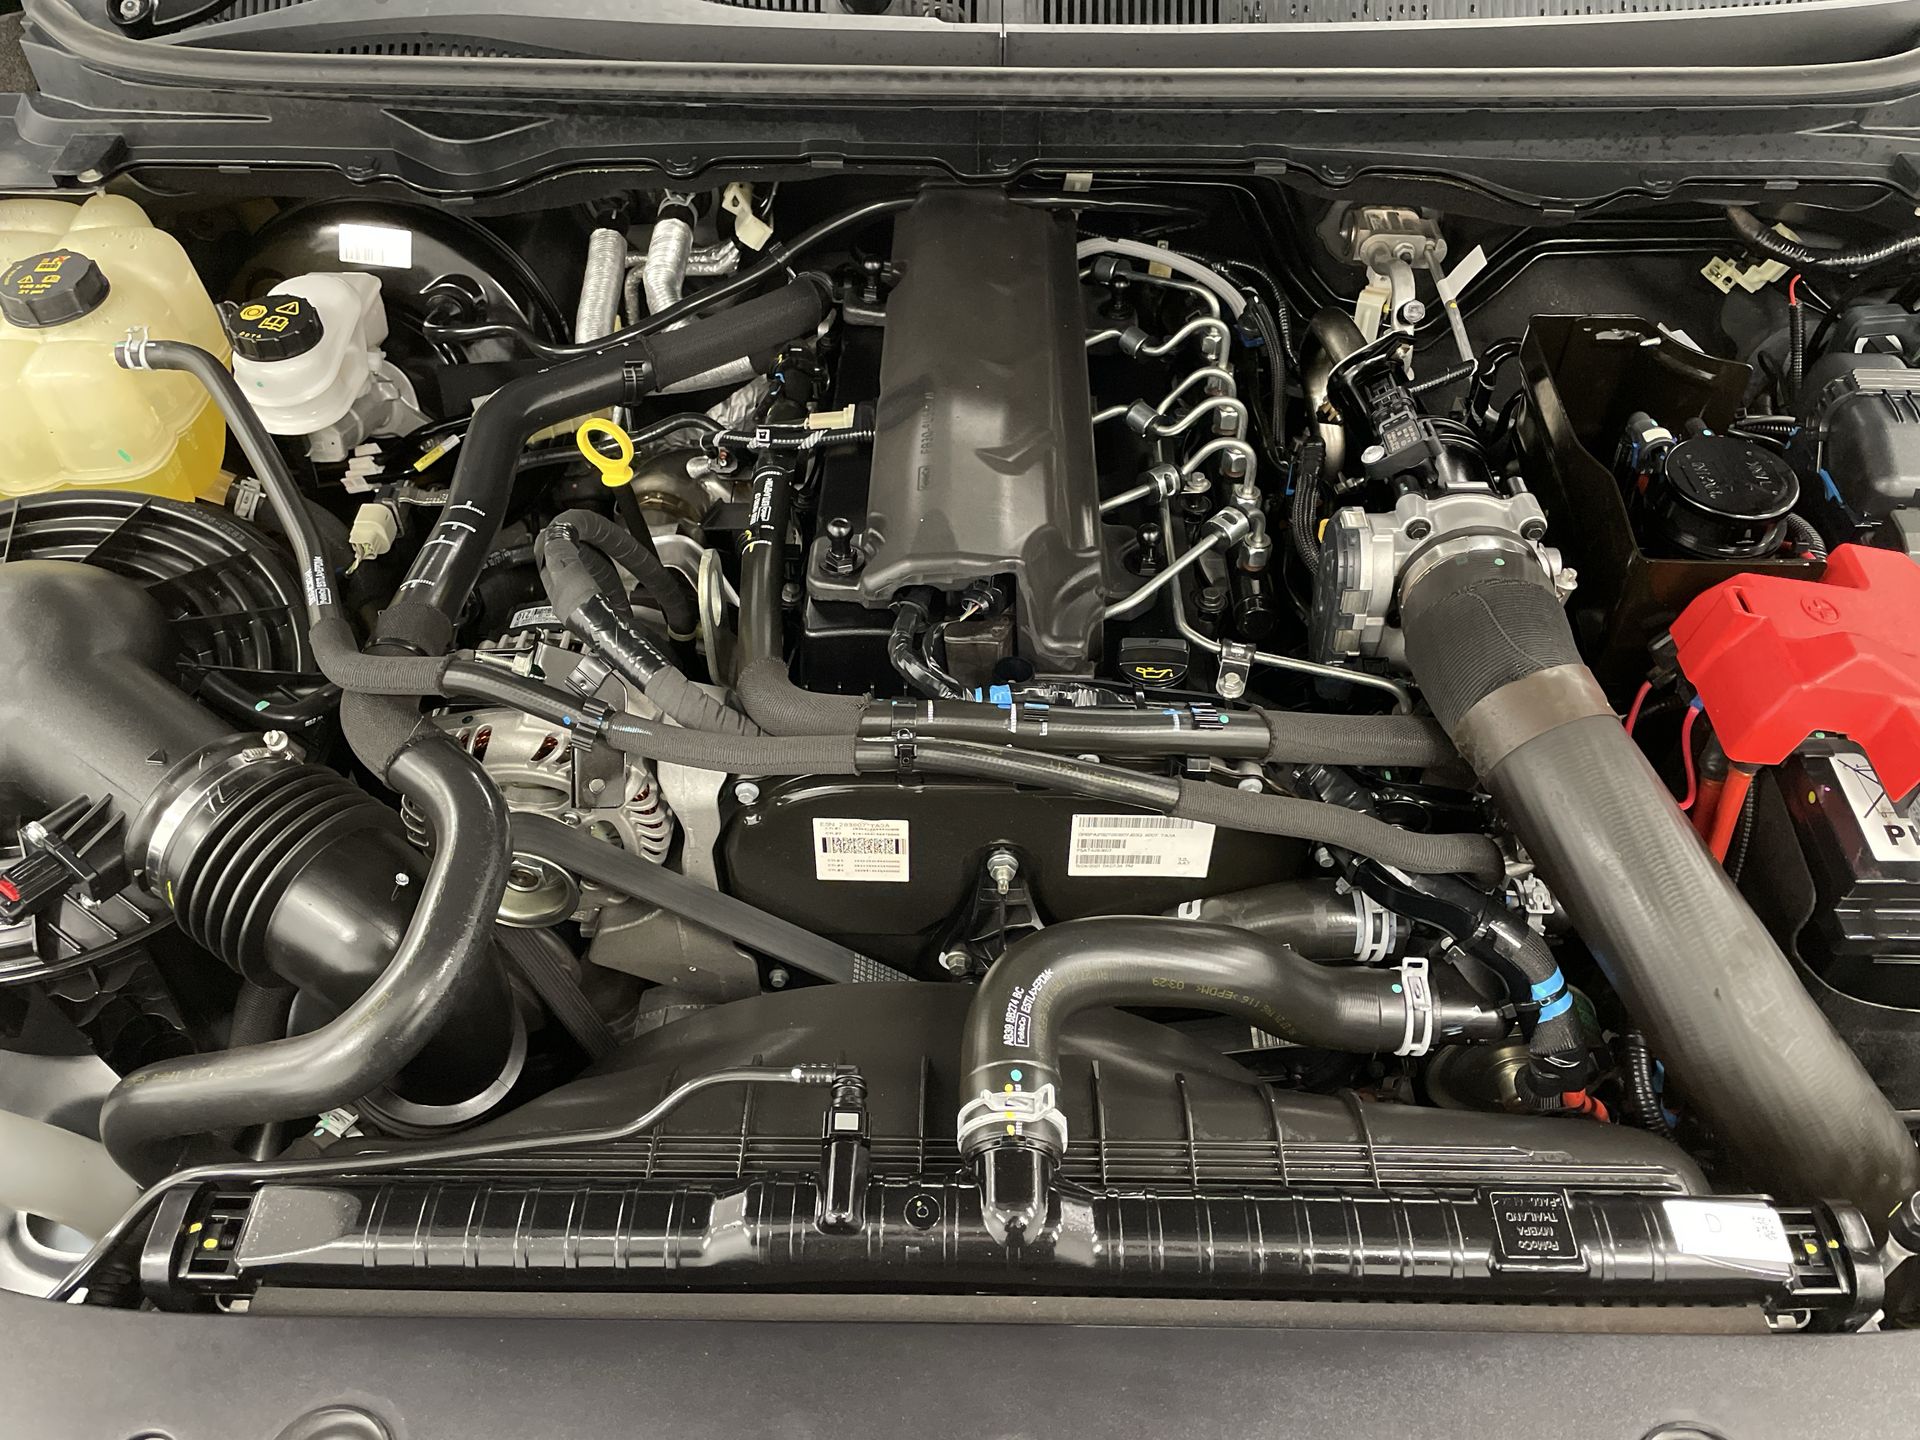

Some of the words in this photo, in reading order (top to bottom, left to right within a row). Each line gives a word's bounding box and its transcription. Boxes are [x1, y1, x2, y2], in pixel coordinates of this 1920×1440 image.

[1012, 986, 1025, 1000] BC
[1005, 998, 1020, 1023] 8B274
[1003, 1023, 1014, 1046] AB39
[1505, 1212, 1559, 1223] THAILAND
